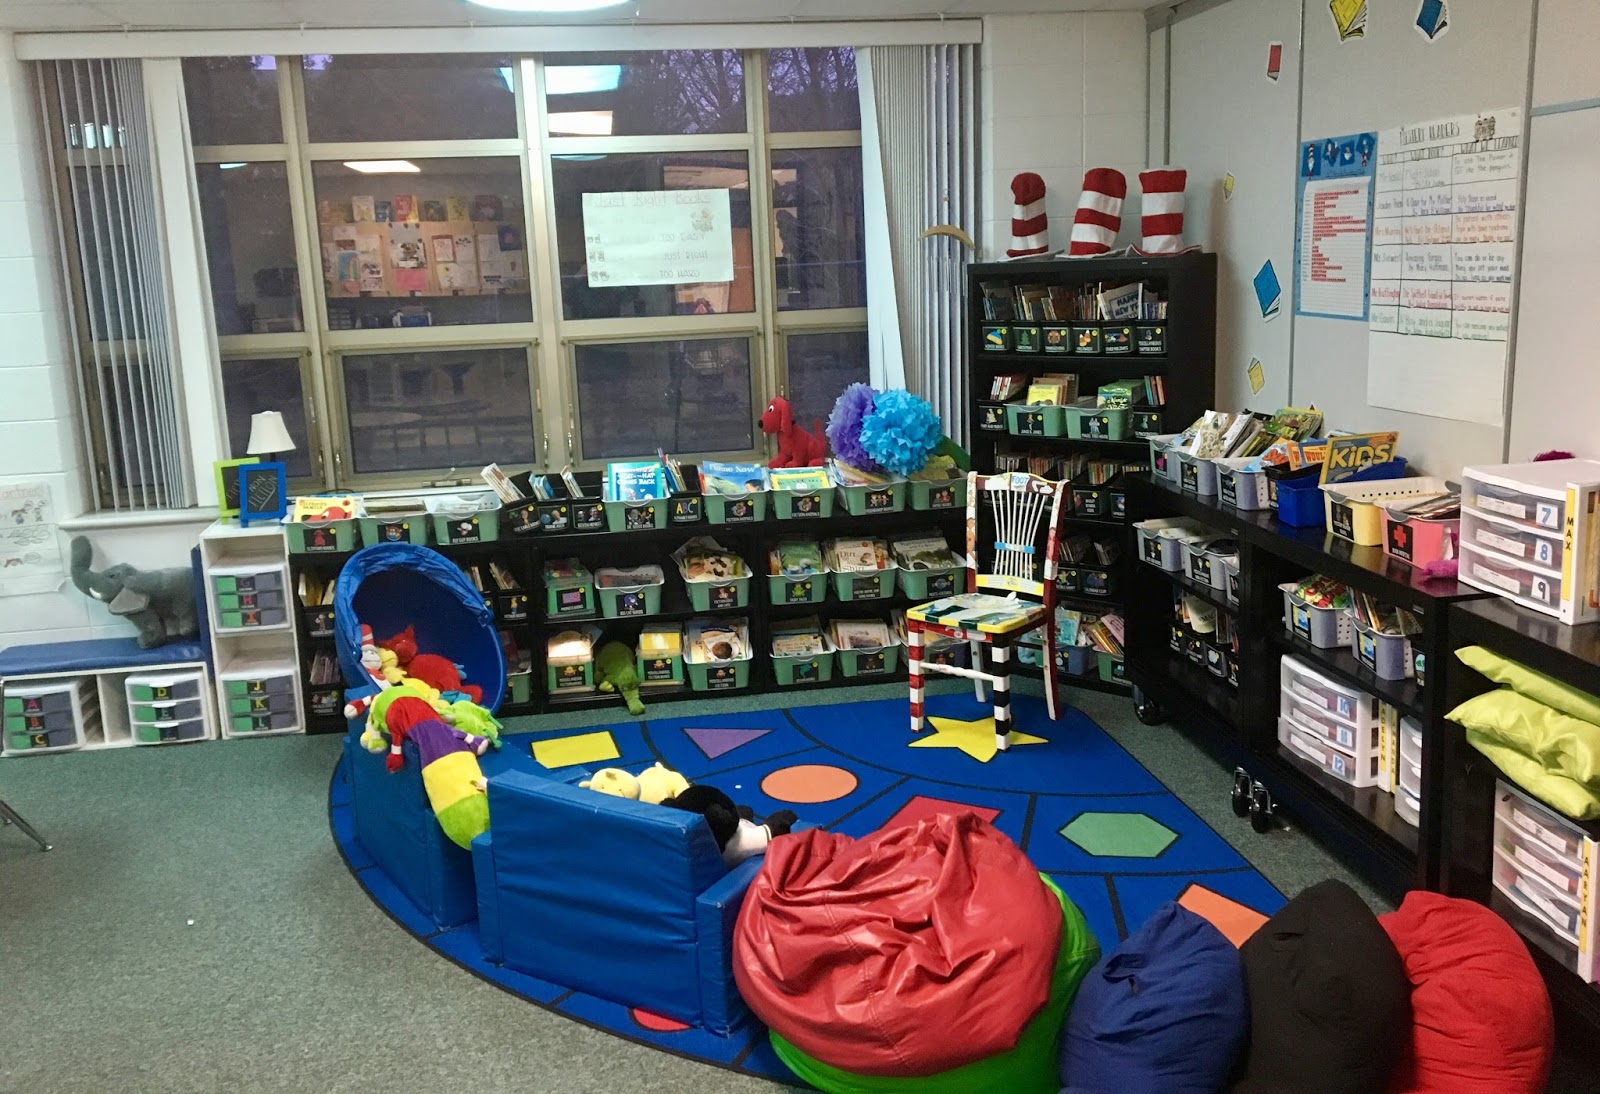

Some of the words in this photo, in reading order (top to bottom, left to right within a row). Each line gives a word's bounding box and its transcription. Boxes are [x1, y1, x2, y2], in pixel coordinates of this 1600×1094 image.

[660, 270, 673, 278] TOO
[677, 269, 699, 278] HARD
[709, 464, 733, 473] Home
[249, 475, 265, 492] NON
[1012, 476, 1030, 484] FOOT
[676, 502, 694, 514] ABC
[1541, 507, 1551, 524] 7
[1566, 517, 1574, 551] MAX
[1540, 544, 1548, 561] 8
[1538, 581, 1546, 599] 9
[254, 680, 260, 691] J
[158, 687, 167, 697] D
[27, 699, 38, 709] A
[256, 699, 265, 708] K
[1340, 698, 1349, 713] 10
[35, 734, 45, 744] C
[1340, 730, 1348, 743] 11
[1335, 757, 1344, 773] 12
[1581, 856, 1590, 928] AARYAN
